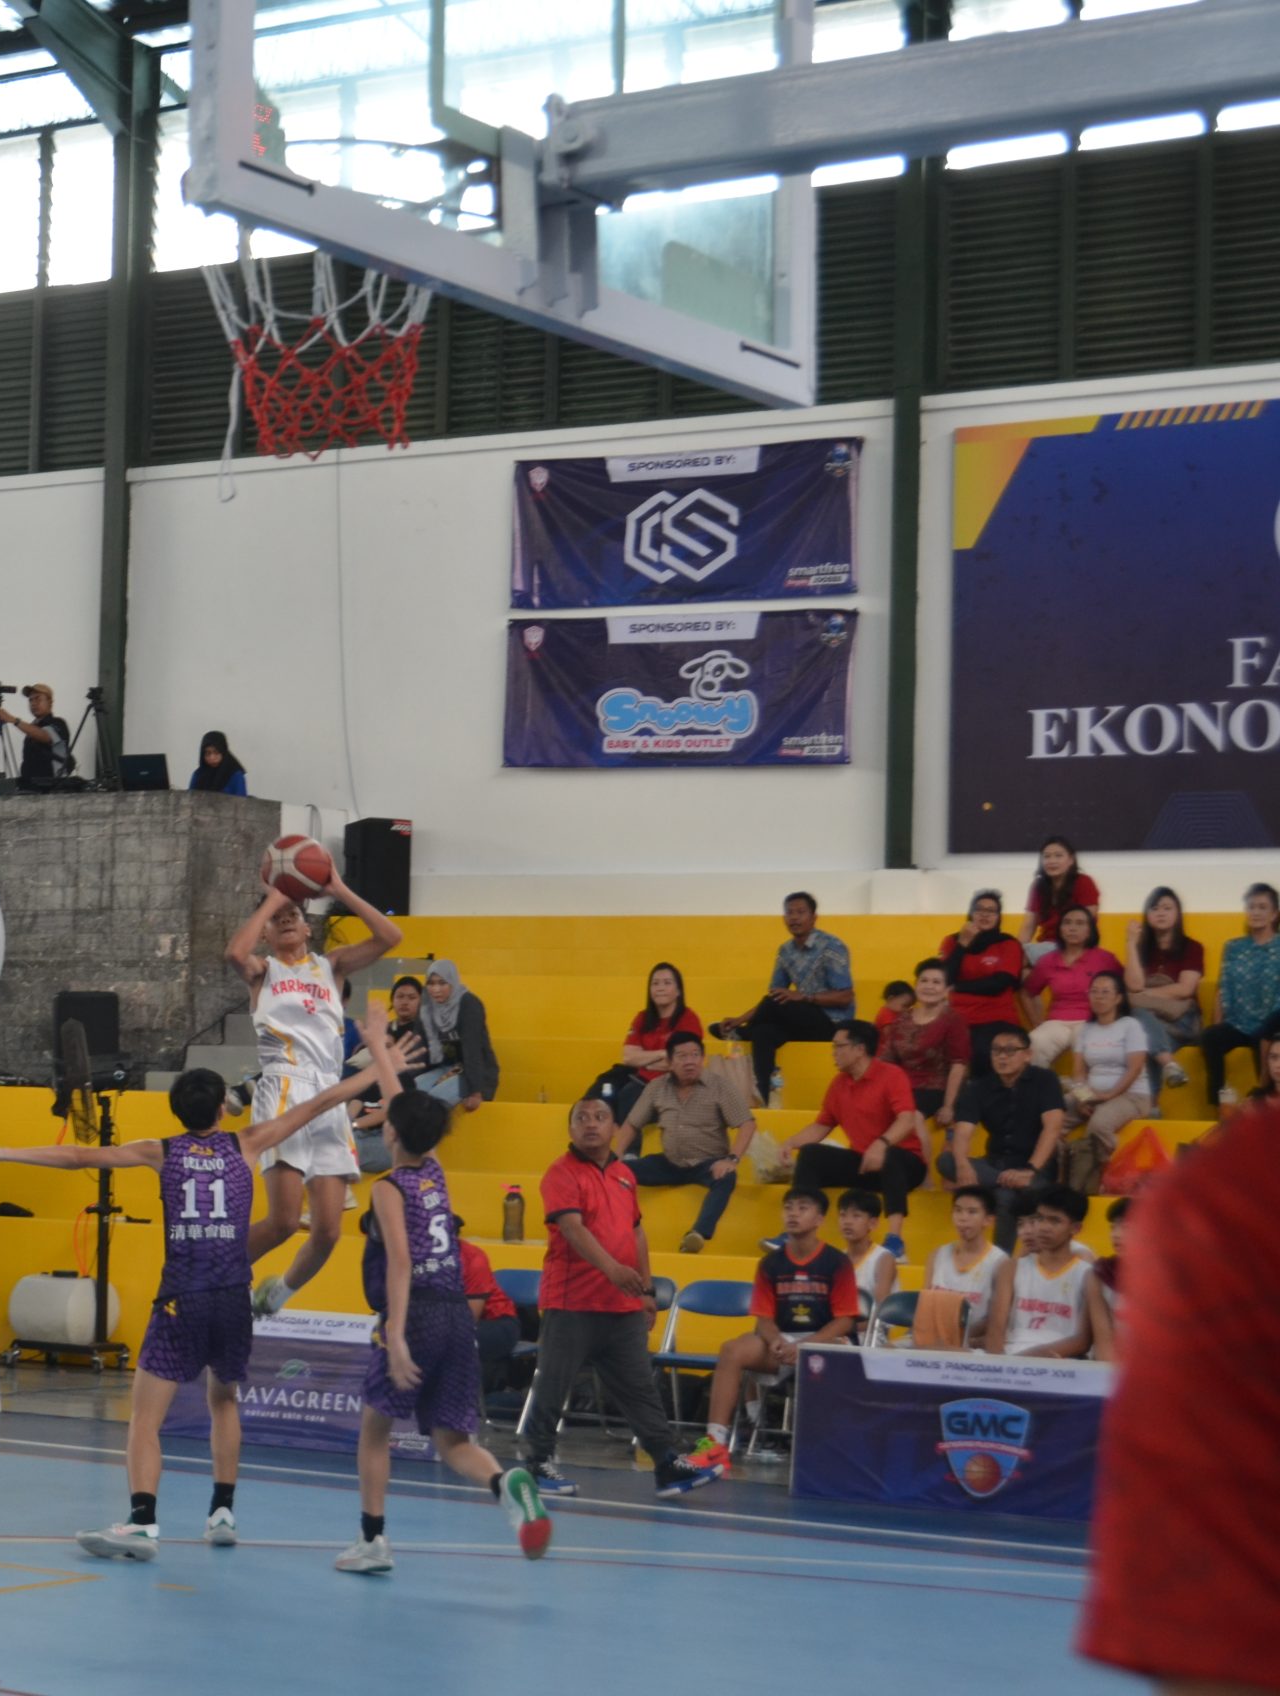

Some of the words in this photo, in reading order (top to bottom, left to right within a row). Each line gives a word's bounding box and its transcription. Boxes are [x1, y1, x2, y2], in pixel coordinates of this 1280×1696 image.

[628, 456, 710, 472] SPONSORED
[715, 454, 736, 466] BY:
[628, 620, 711, 634] SPONSORED
[715, 620, 736, 632] BY:
[607, 738, 638, 750] BABY
[640, 738, 650, 749] &
[652, 737, 681, 749] KIDS
[684, 736, 732, 748] OUTLET
[180, 1178, 228, 1219] 11
[944, 1360, 1004, 1375] PANGDAM
[1022, 1366, 1049, 1377] CUP
[235, 1385, 363, 1413] AAVAGREEN
[946, 1411, 1024, 1439] GMC
